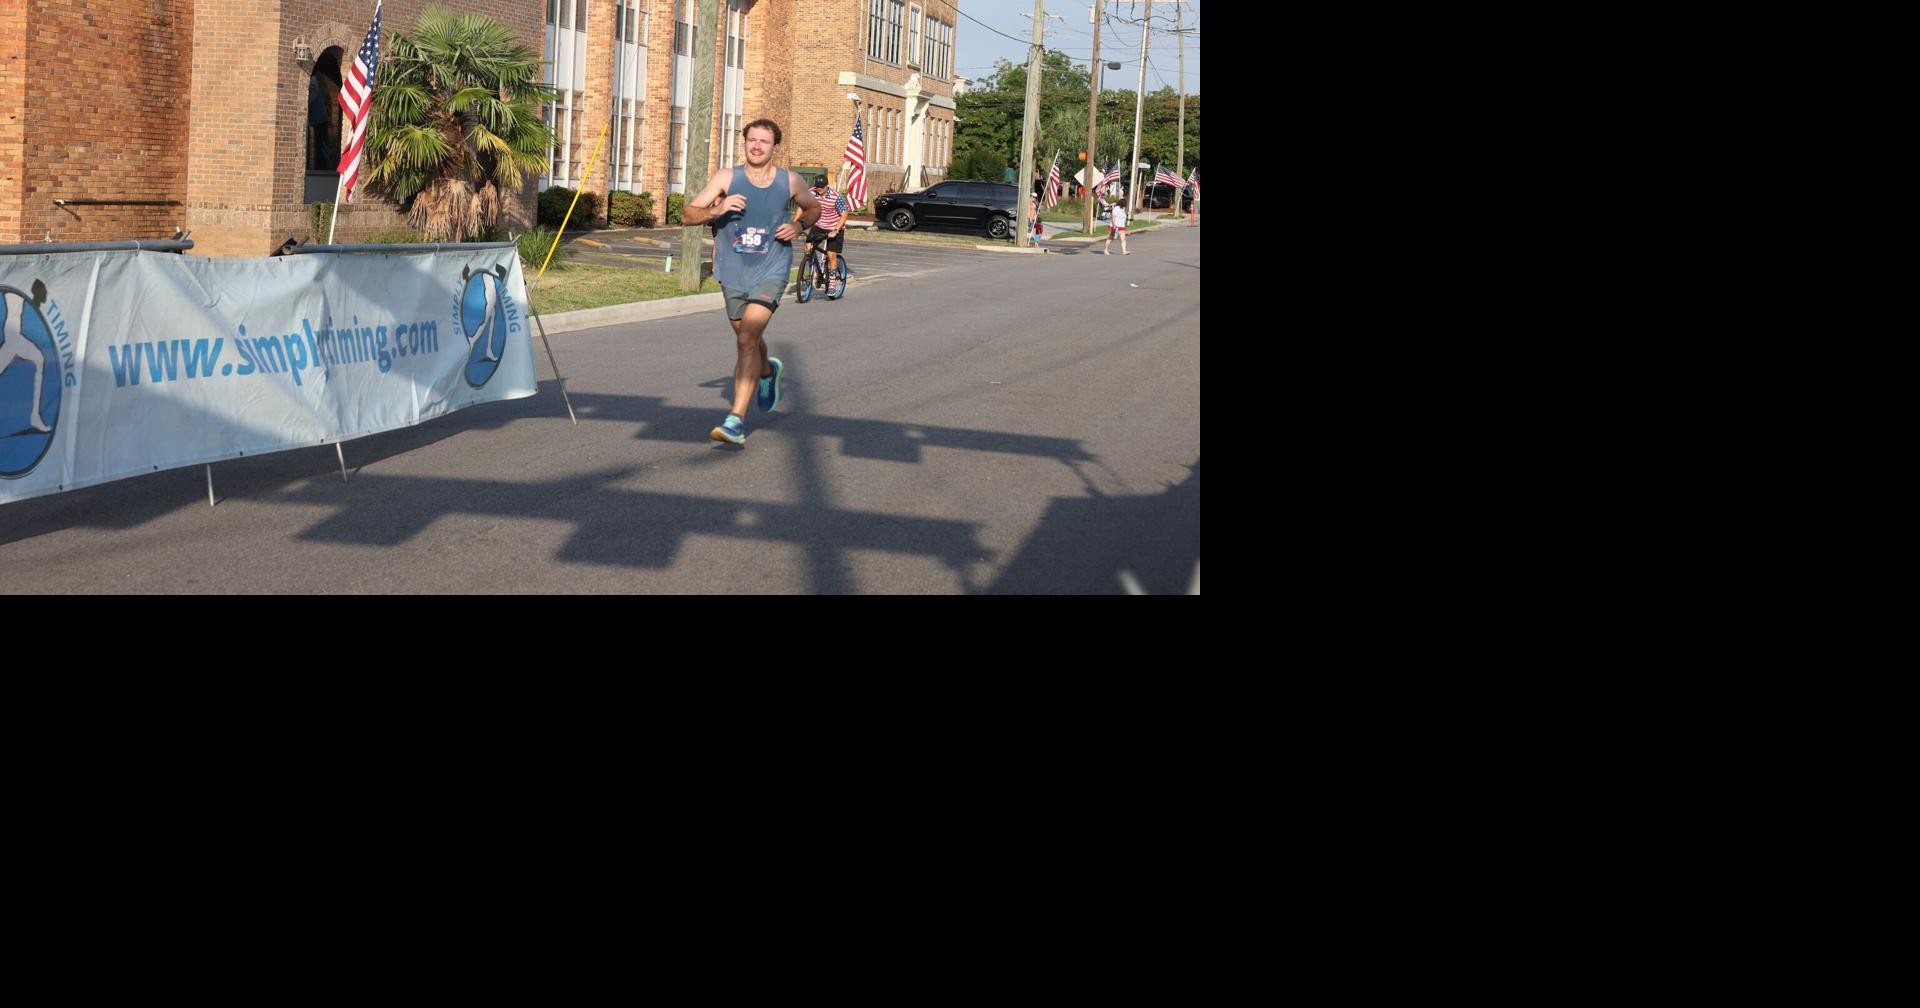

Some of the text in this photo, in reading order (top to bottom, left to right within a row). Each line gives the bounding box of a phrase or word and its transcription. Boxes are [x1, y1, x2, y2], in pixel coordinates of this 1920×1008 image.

[741, 234, 762, 246] 158
[501, 287, 521, 333] MING
[47, 299, 77, 387] TIMING
